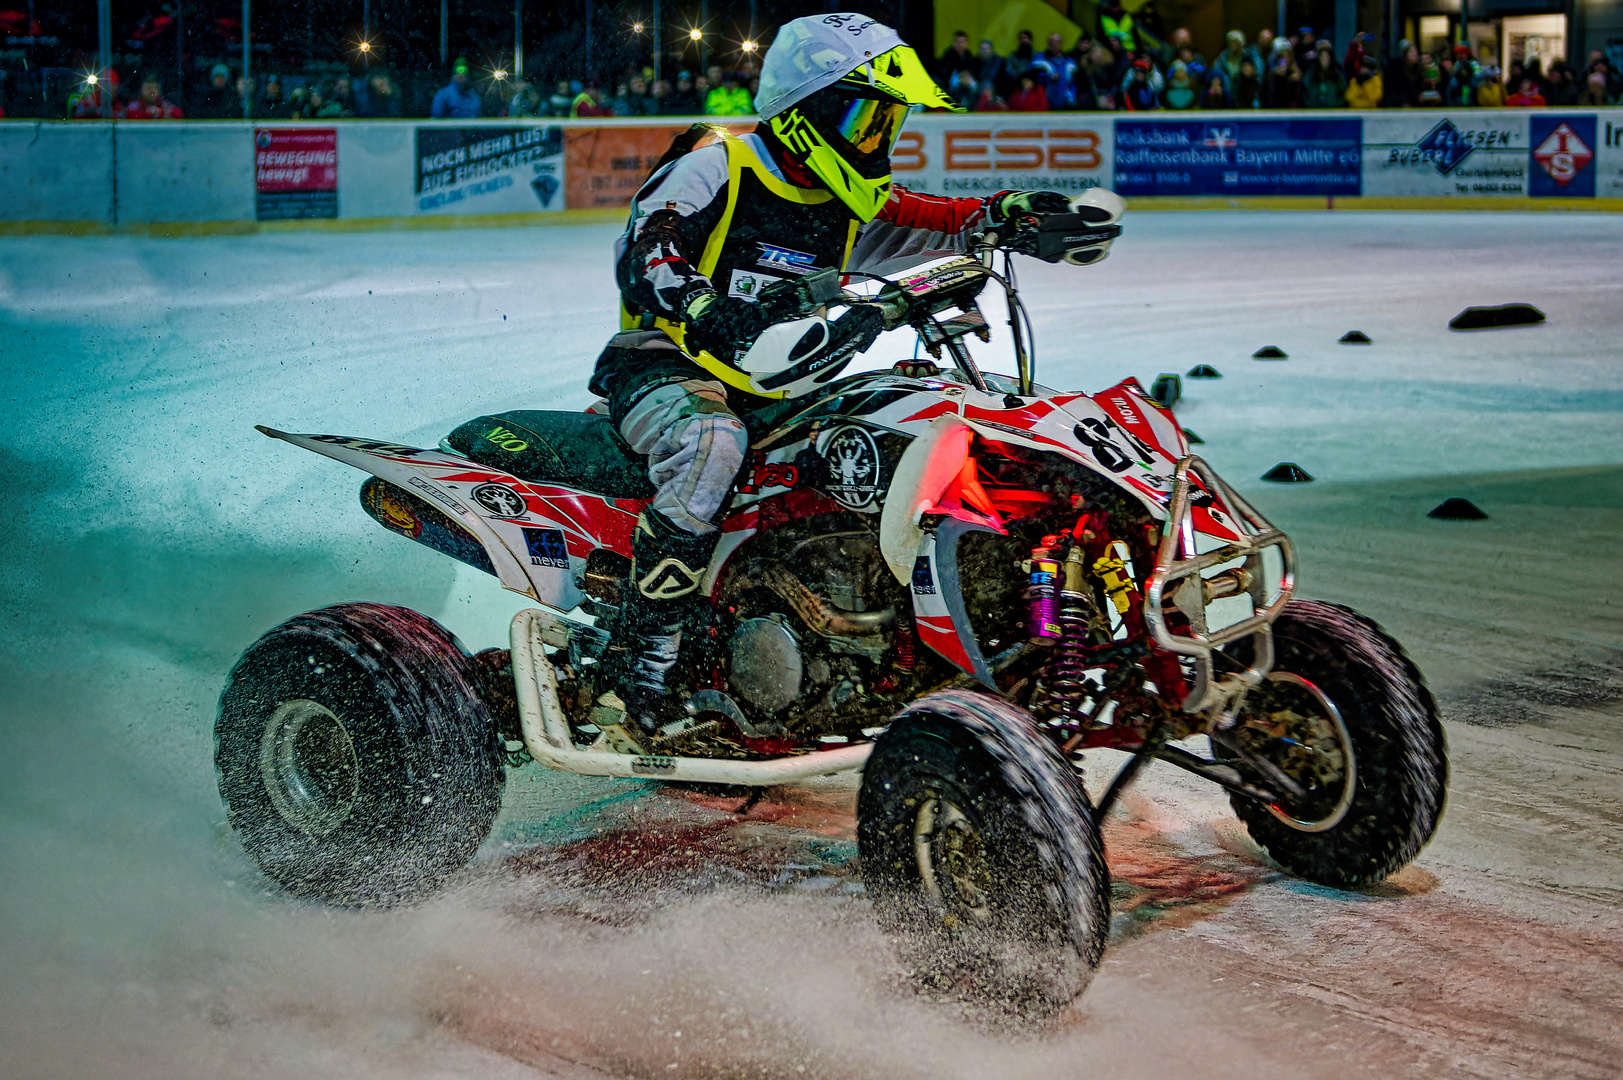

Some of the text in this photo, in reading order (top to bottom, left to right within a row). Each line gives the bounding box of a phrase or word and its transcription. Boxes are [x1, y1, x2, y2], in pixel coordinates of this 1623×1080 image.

[1115, 127, 1190, 145] Volksbank
[421, 146, 467, 175] NOCH
[469, 134, 514, 161] MEHR
[944, 129, 1102, 171] ESB
[1115, 148, 1360, 167] Raiffeisenbank Bayern Mitte eG
[943, 176, 1004, 191] ENERGIE
[1009, 173, 1100, 191] SÜDBAYERN
[1110, 396, 1140, 425] MOTUL
[486, 426, 528, 452] NEO
